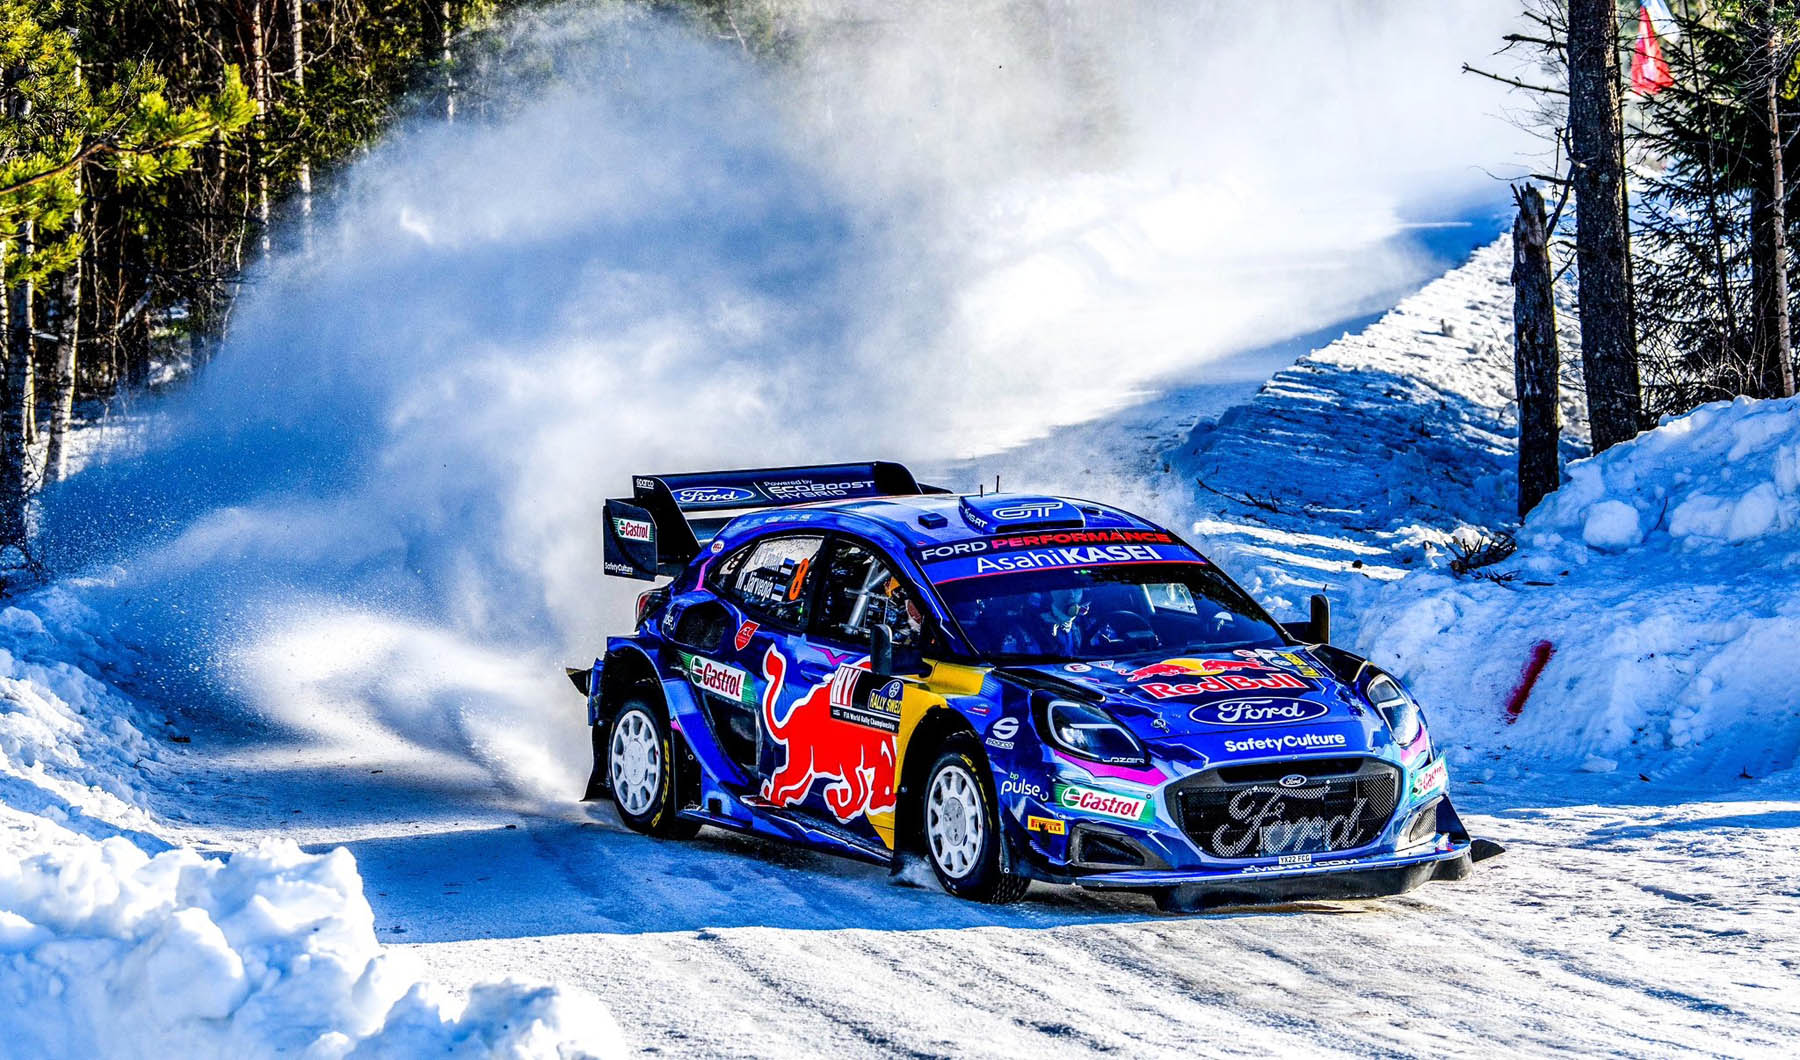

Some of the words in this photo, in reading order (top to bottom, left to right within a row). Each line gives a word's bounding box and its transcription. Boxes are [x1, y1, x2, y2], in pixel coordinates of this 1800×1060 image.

[763, 479, 801, 487] Powered
[768, 480, 875, 494] ECOBOOST
[680, 488, 739, 502] Ford
[775, 489, 848, 500] HYBRID
[625, 523, 649, 539] Castrol
[921, 541, 988, 561] FORD
[991, 531, 1172, 549] PERFORMANCE
[977, 546, 1162, 573] AsahiKASEI
[789, 558, 808, 601] 8
[703, 662, 742, 697] Castrol
[1138, 677, 1232, 699] Red
[1219, 673, 1309, 690] Bull
[869, 692, 887, 710] RALLY
[1217, 699, 1305, 723] Ford
[850, 712, 861, 722] World
[870, 717, 895, 731] Championship
[986, 738, 1014, 749] sparco
[1224, 733, 1346, 753] SafetyCulture
[1009, 772, 1019, 781] bp
[1000, 778, 1041, 797] pulse
[1079, 792, 1140, 817] Castrol
[1211, 785, 1369, 858] Ford
